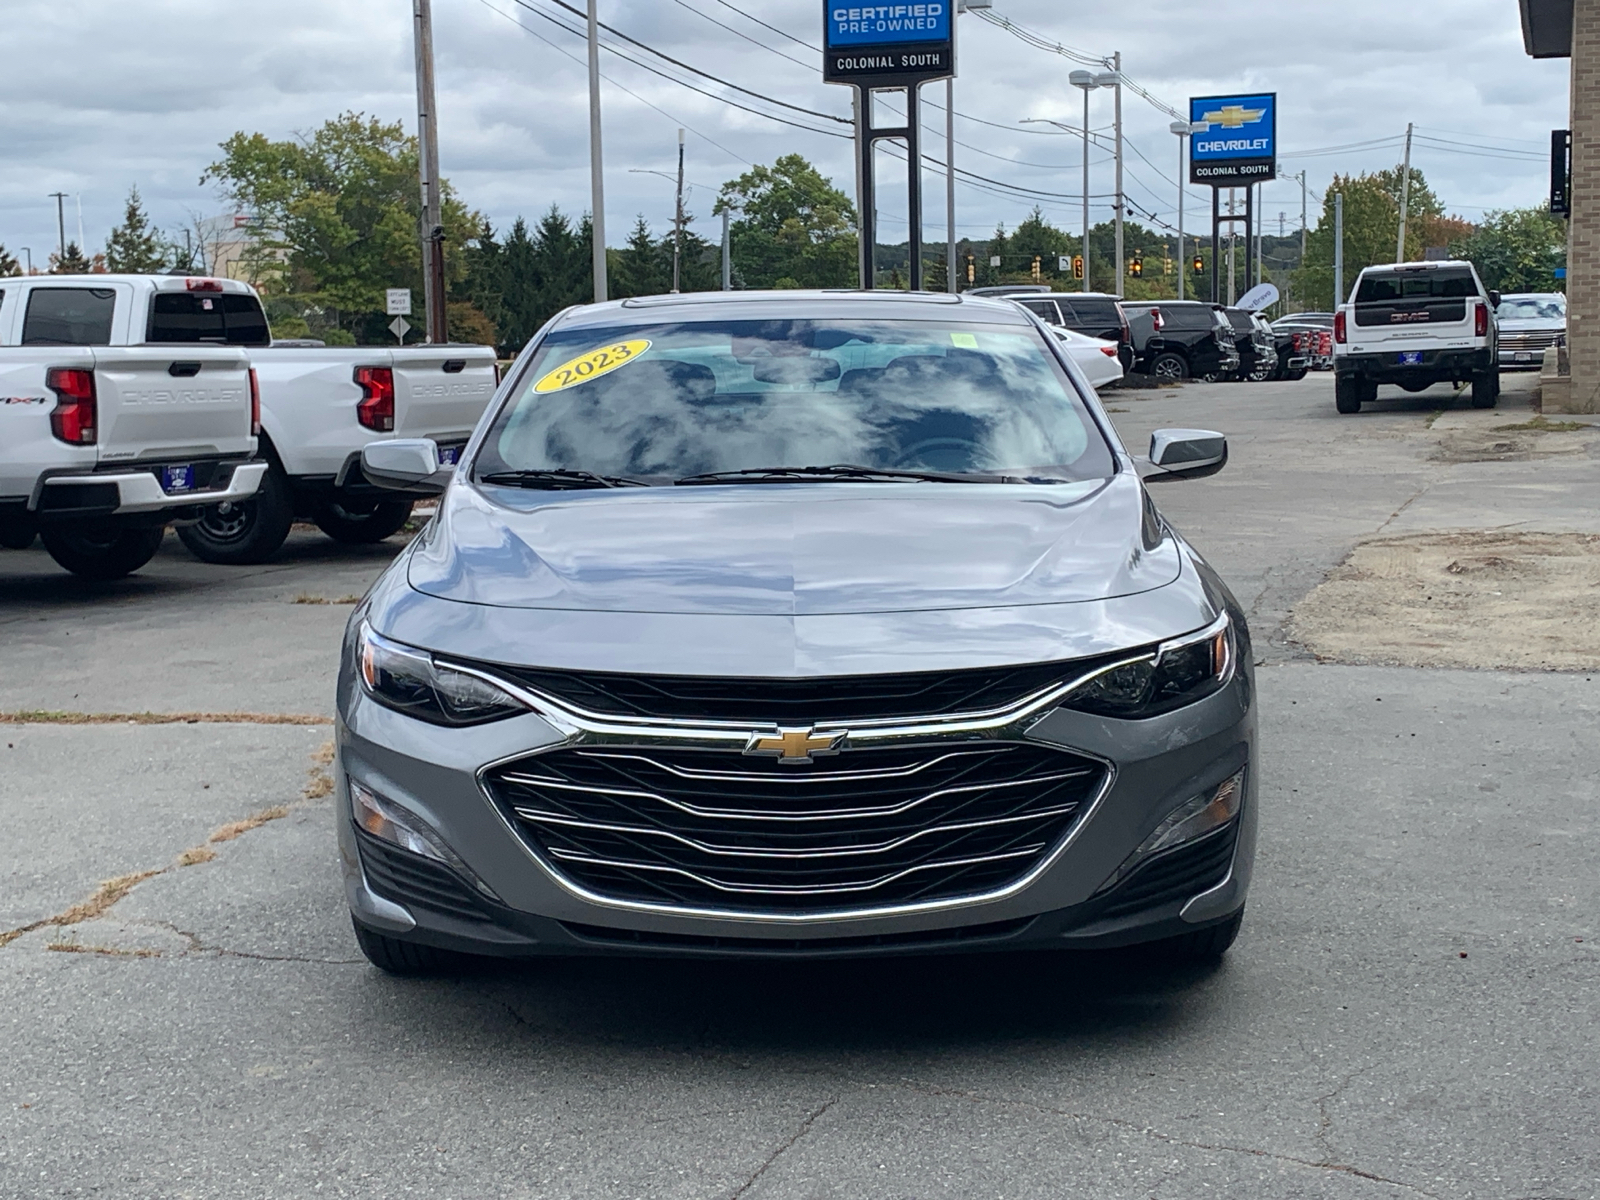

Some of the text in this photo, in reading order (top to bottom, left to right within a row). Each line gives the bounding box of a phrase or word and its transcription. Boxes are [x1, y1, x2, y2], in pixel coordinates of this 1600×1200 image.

[833, 4, 943, 21] CERTIFIED
[838, 17, 937, 34] PRE-OWNED
[836, 53, 940, 70] COLONIAL SOUTH
[1197, 138, 1269, 152] CHEVROLET
[1196, 165, 1269, 176] COLONIAL SOUTH
[1391, 311, 1430, 322] GMC
[555, 345, 633, 387] 2023
[122, 387, 243, 406] CHEVROLET
[412, 382, 493, 398] CHEVROLET
